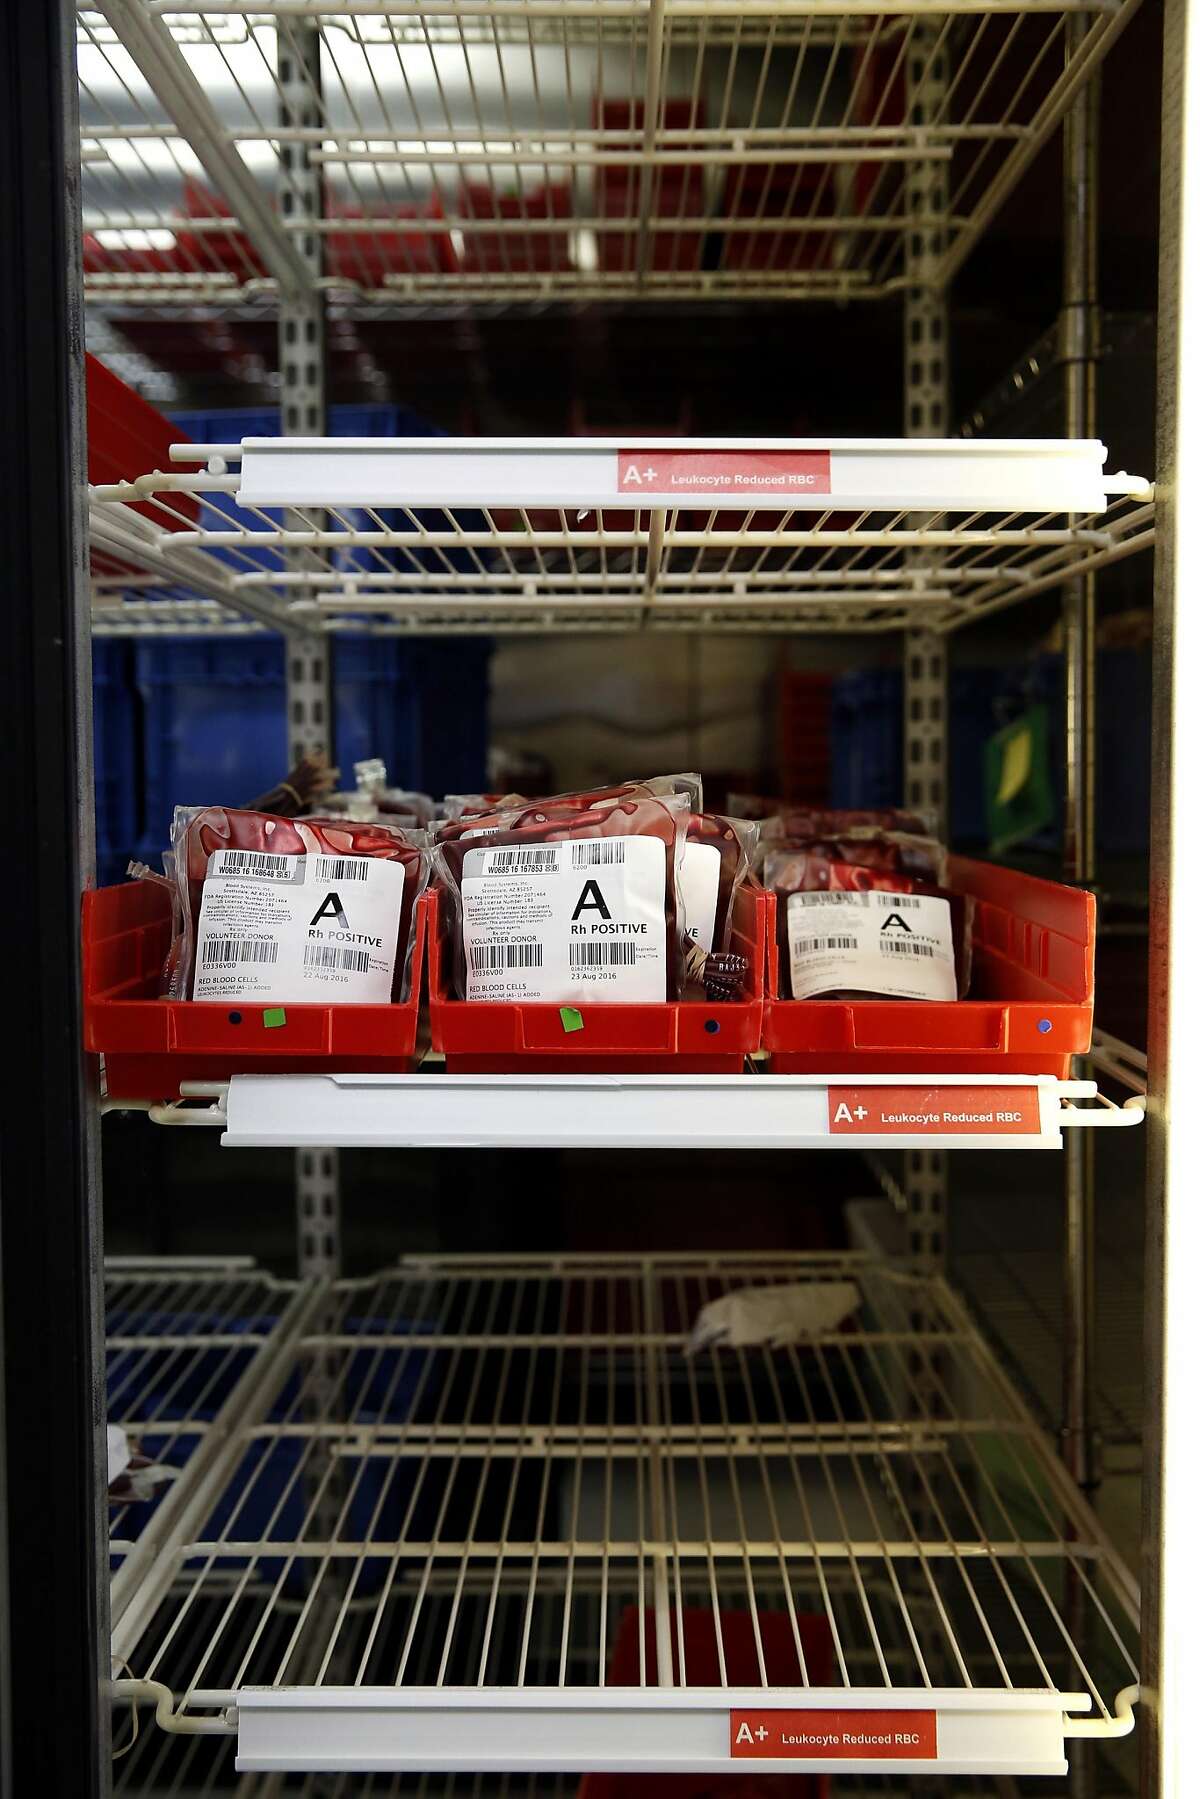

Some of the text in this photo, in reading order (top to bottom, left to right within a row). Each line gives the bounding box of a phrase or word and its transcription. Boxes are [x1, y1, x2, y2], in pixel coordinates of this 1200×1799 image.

[623, 465, 815, 486] A+ Leukocyte Reduced RBC
[242, 867, 250, 875] 16
[488, 866, 510, 874] W0685
[511, 865, 518, 873] 16
[520, 865, 543, 873] 167853
[571, 879, 612, 921] A
[309, 892, 350, 929] A
[880, 913, 912, 932] A
[571, 923, 648, 935] Rh POSITIVE
[206, 932, 274, 941] VOLUNTEER DONOR
[308, 929, 383, 948] Rh POSITIVE
[470, 936, 509, 945] VOLUNTEER
[199, 977, 211, 985] RED
[213, 976, 236, 984] BLOOD
[315, 972, 328, 981] Aug
[330, 975, 349, 983] 2016
[582, 973, 597, 981] Aug
[598, 972, 617, 980] 2016
[469, 985, 481, 993] RED
[482, 984, 505, 992] BLOOD
[834, 1103, 1022, 1124] A+ Leukocyte Reduced RBC
[735, 1722, 919, 1746] A+ Leukocyte Reduced RBC
